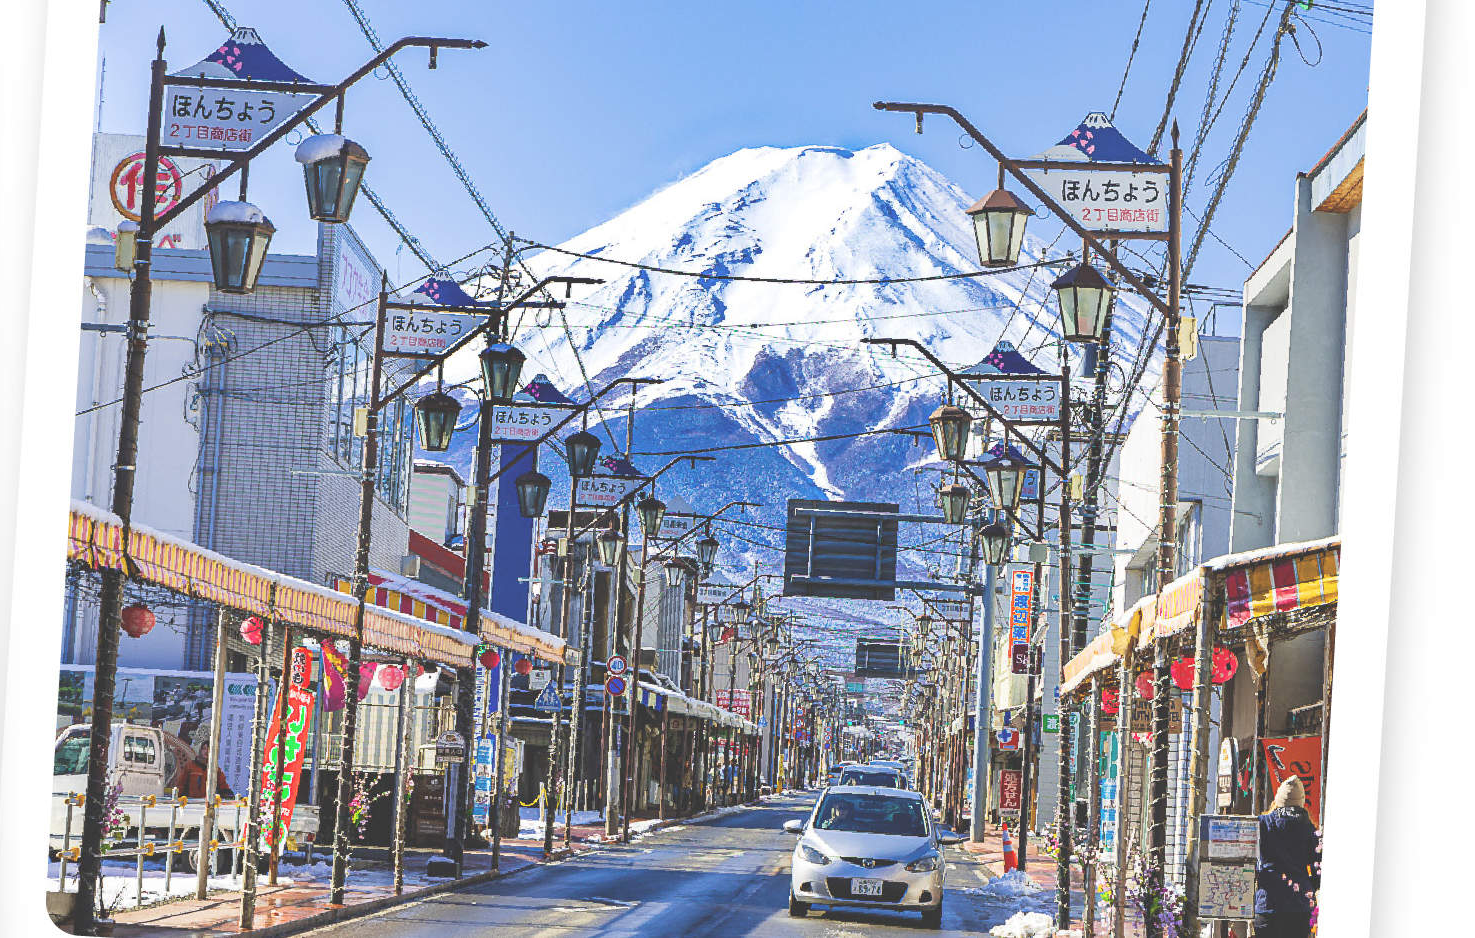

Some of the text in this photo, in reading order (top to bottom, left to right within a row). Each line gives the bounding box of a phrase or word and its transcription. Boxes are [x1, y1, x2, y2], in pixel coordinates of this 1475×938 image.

[172, 95, 275, 123] ほんちょう
[170, 124, 253, 142] 2丁目商店街
[1062, 179, 1159, 203] ほんちょう
[1082, 208, 1159, 222] 2丁目商店街
[392, 315, 462, 335] ほんちょう
[990, 385, 1055, 401] ほんちょう
[495, 411, 552, 426] ほんちょう
[1012, 595, 1030, 645] 渡辺薬
